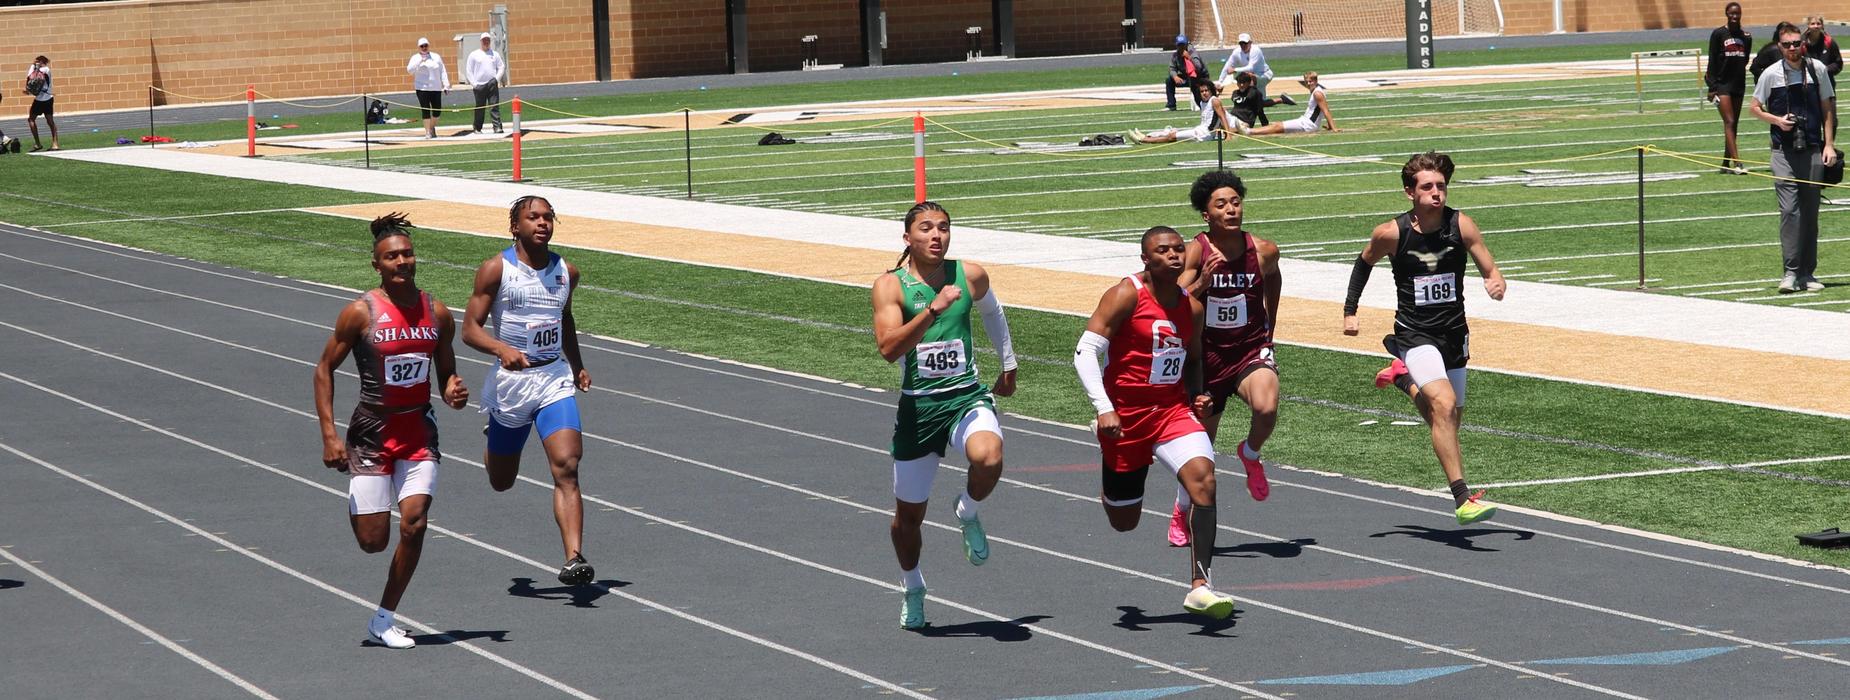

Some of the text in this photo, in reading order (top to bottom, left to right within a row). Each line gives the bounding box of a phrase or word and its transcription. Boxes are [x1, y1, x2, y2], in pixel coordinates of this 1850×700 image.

[1209, 273, 1256, 288] ILLEY
[1422, 282, 1451, 301] 169
[1217, 305, 1238, 322] 59
[374, 326, 439, 343] SHARKS
[532, 327, 559, 347] 405
[925, 350, 959, 371] 493
[1162, 357, 1181, 377] 28
[391, 360, 423, 383] 327
